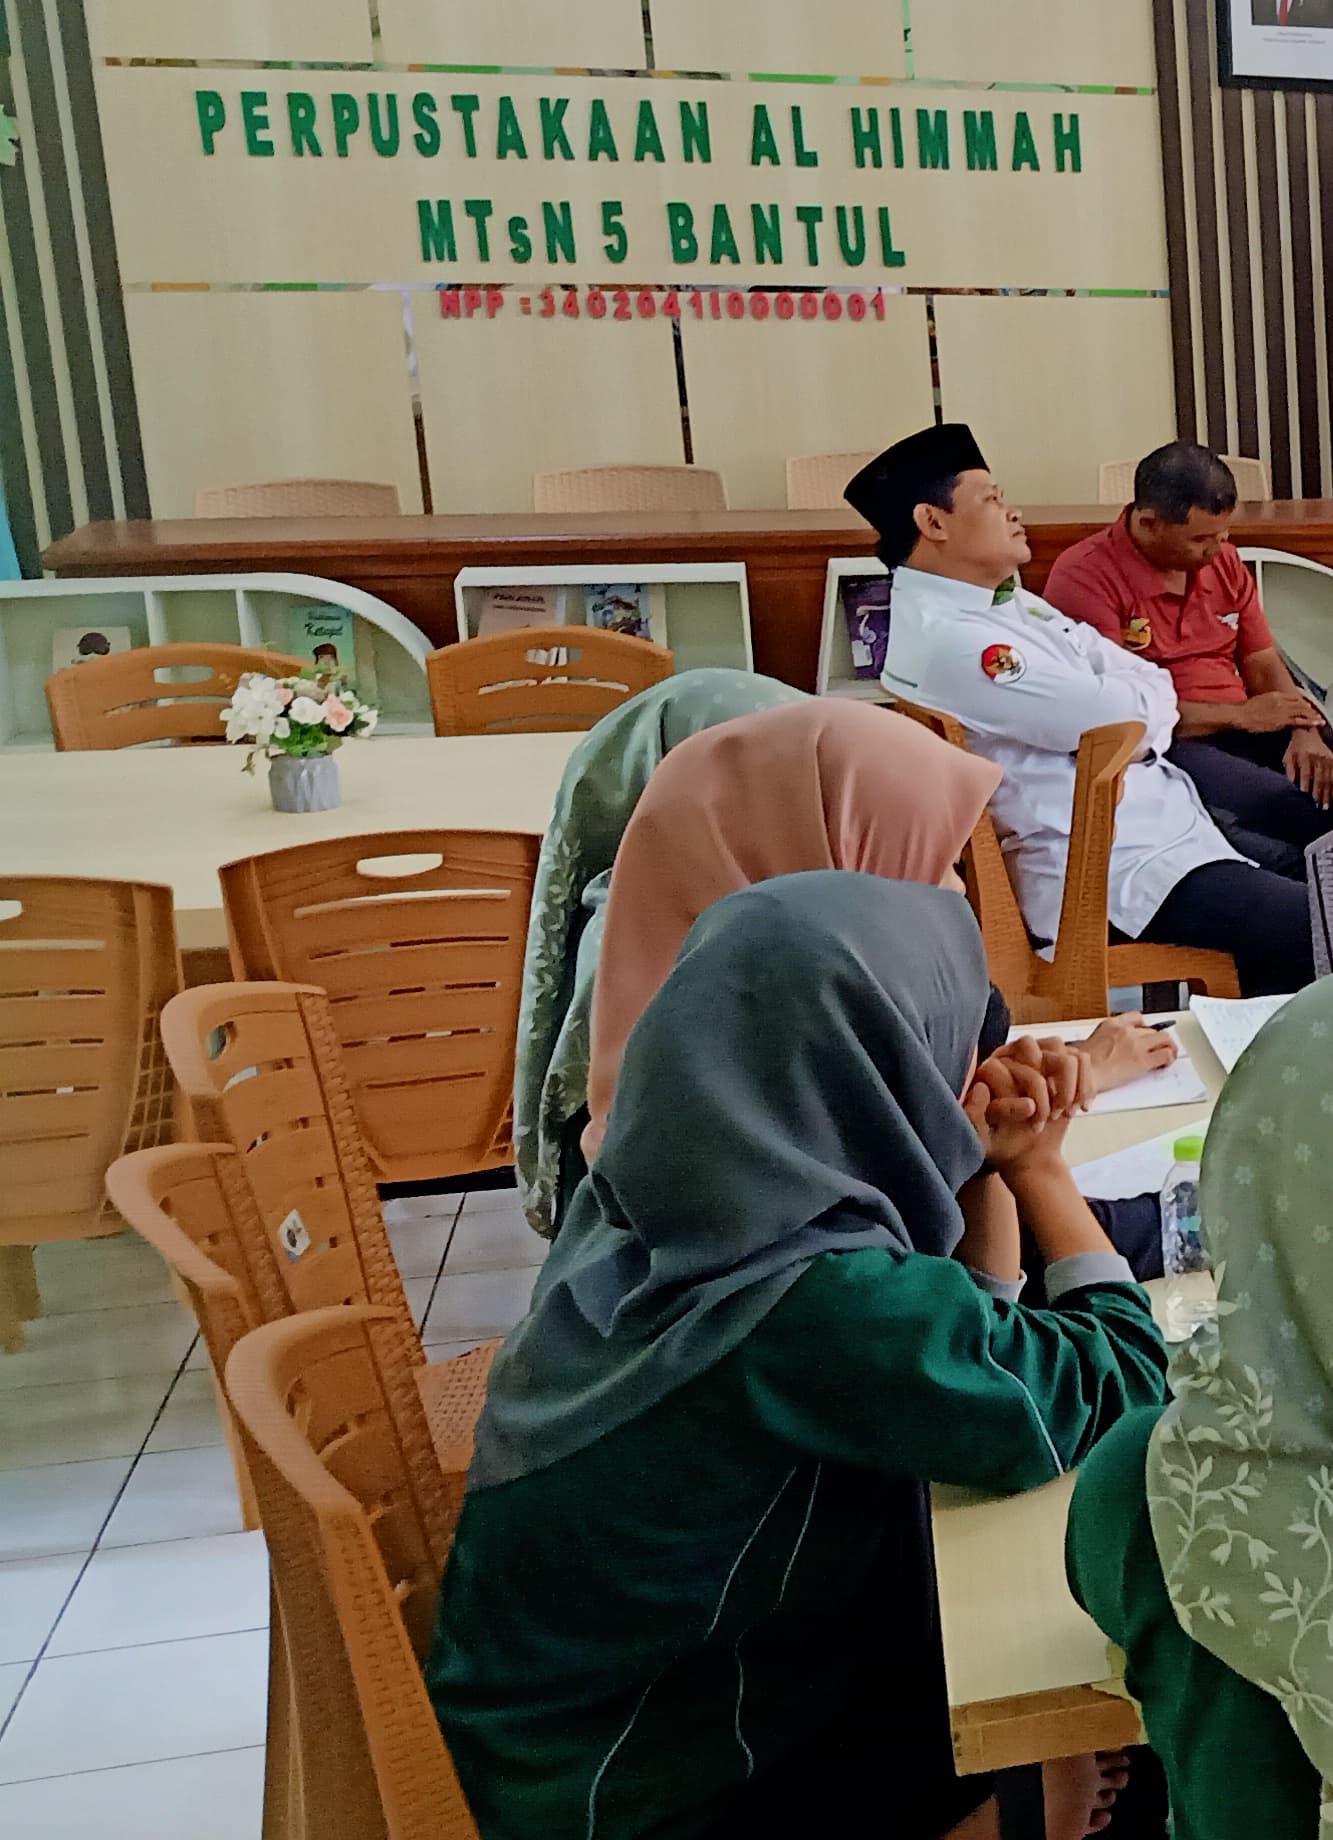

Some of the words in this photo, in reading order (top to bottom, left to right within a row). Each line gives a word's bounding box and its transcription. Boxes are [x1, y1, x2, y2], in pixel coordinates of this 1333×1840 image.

[194, 89, 712, 162] PERPUSTAKAAN
[751, 103, 819, 167] AL
[851, 106, 1082, 172] HIMMAH
[416, 199, 577, 263] MTsN
[601, 200, 629, 263] 5
[665, 201, 907, 267] BANTUL
[441, 288, 505, 316] NPP
